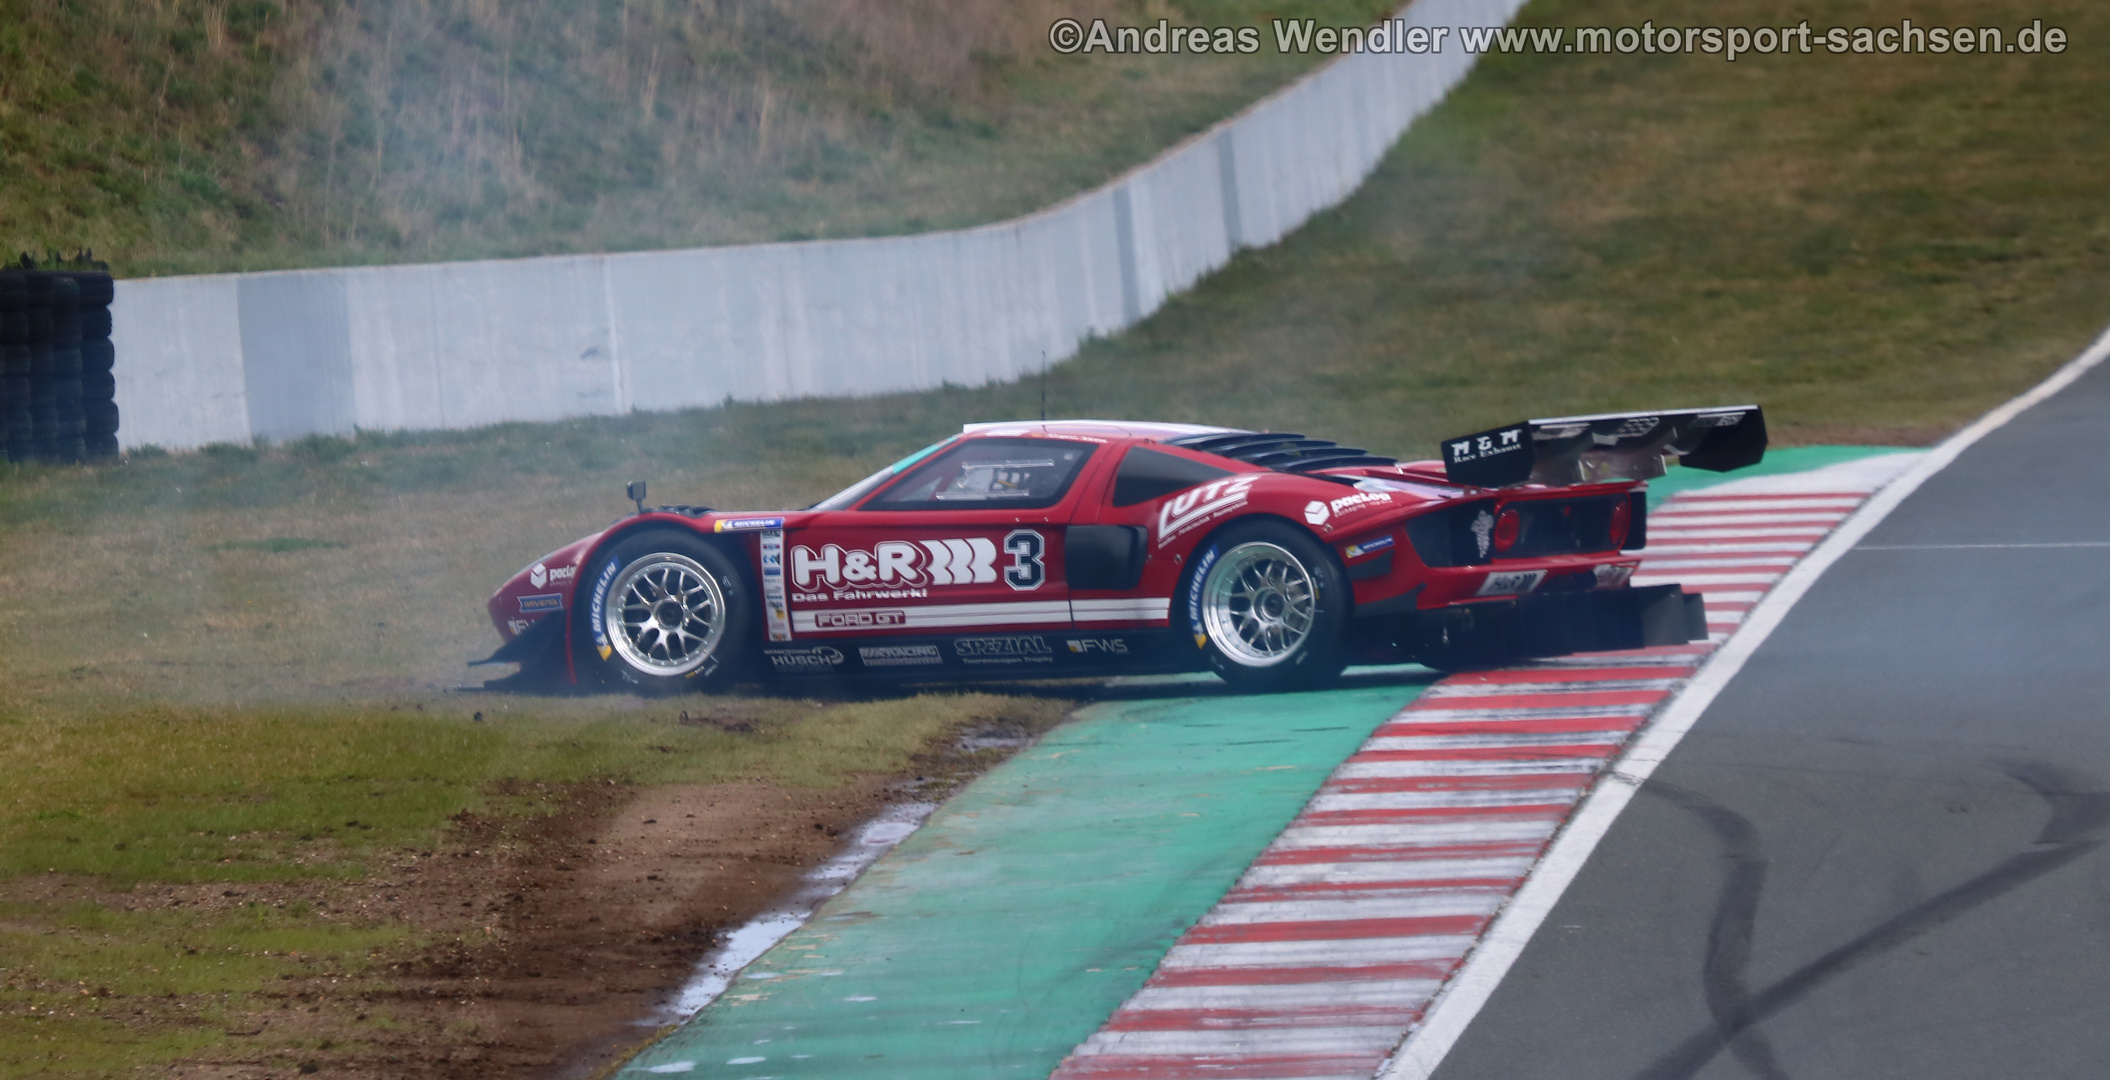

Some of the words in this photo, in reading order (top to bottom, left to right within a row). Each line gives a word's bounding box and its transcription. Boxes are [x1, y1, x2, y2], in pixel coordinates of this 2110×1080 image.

[1451, 440, 1470, 456] M
[1477, 436, 1493, 450] &
[1499, 429, 1522, 445] M
[1454, 454, 1476, 463] Race
[1479, 444, 1522, 457] Exhaust
[1158, 474, 1262, 541] LUTZ
[792, 541, 928, 591] H&R
[1004, 529, 1046, 591] 3
[591, 561, 617, 633] MICHELIN
[792, 592, 828, 603] Das
[1189, 549, 1216, 621] MICHELIN
[818, 613, 872, 628] FORD
[876, 612, 905, 625] GT
[954, 636, 1053, 656] SPEZIAL
[1081, 639, 1127, 654] FWS
